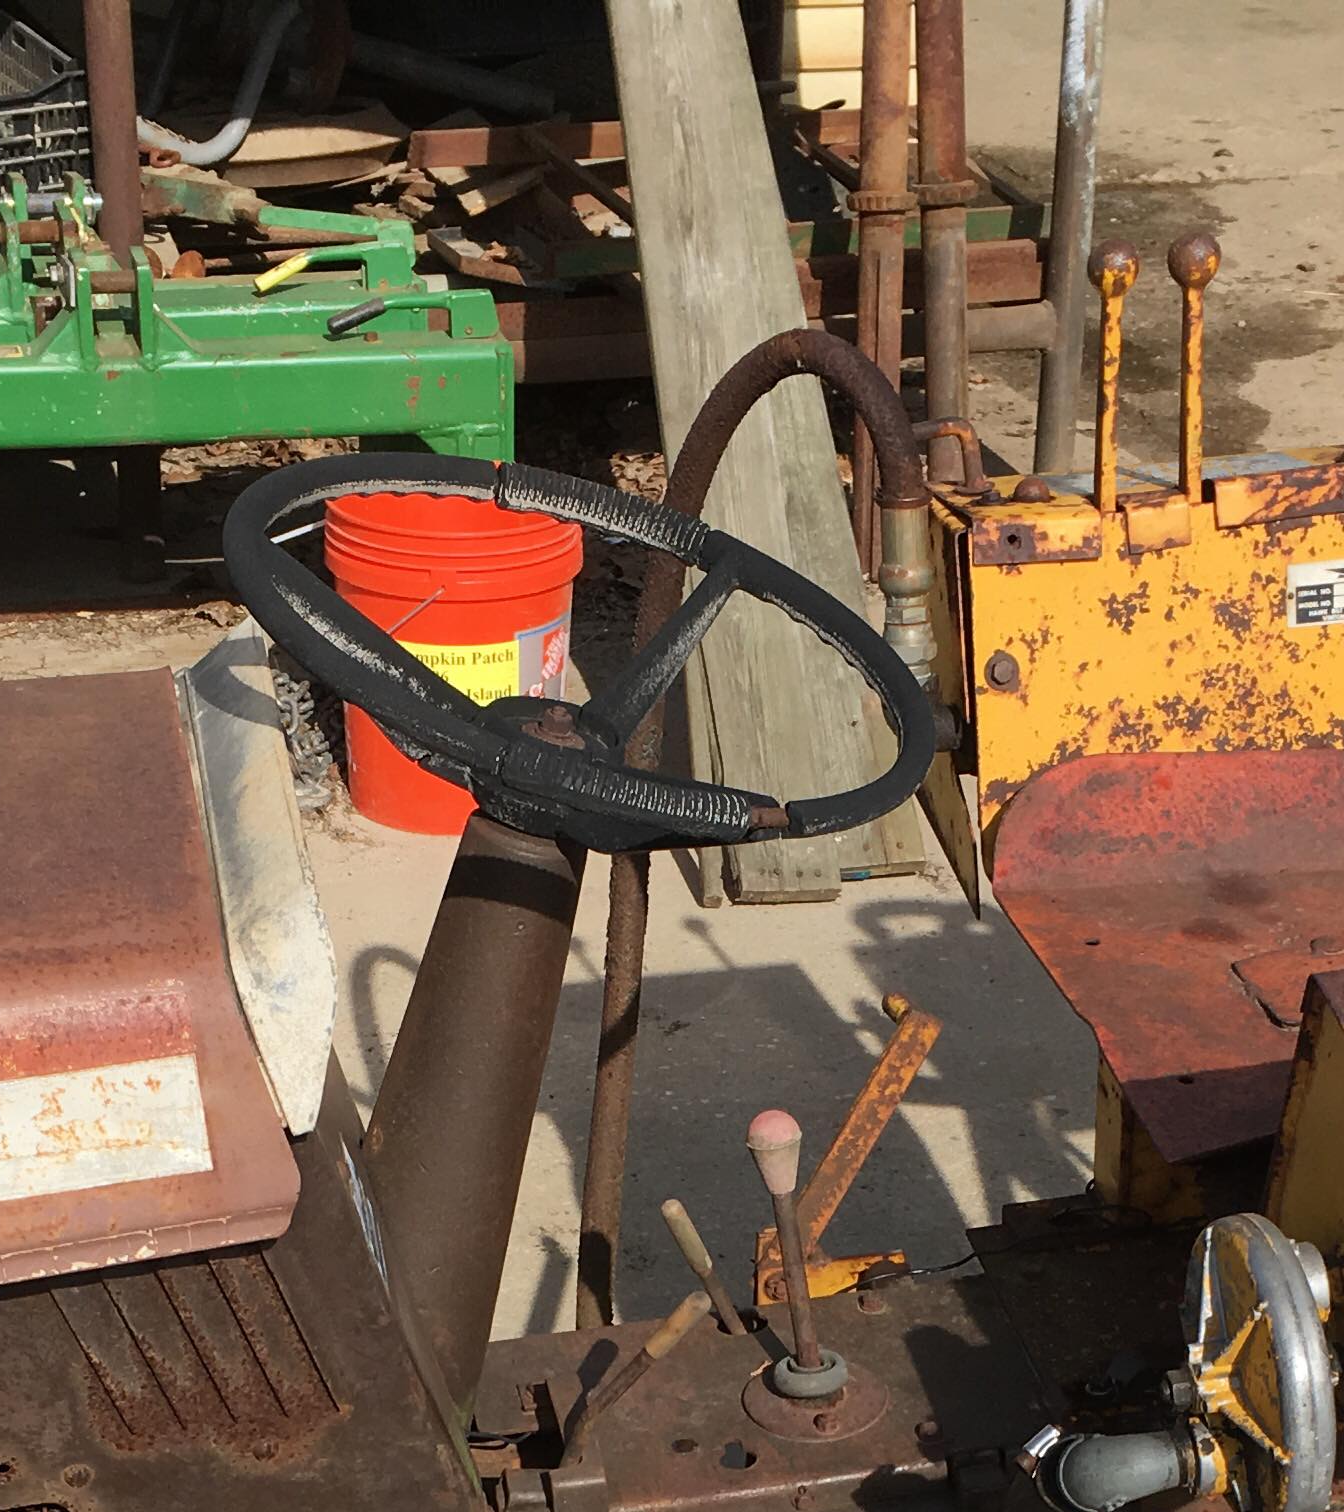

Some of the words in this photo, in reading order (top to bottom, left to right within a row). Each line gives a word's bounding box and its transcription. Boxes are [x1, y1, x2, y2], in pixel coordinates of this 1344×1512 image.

[416, 652, 465, 667] mpkin
[472, 649, 513, 664] Patch
[467, 685, 511, 700] Island
